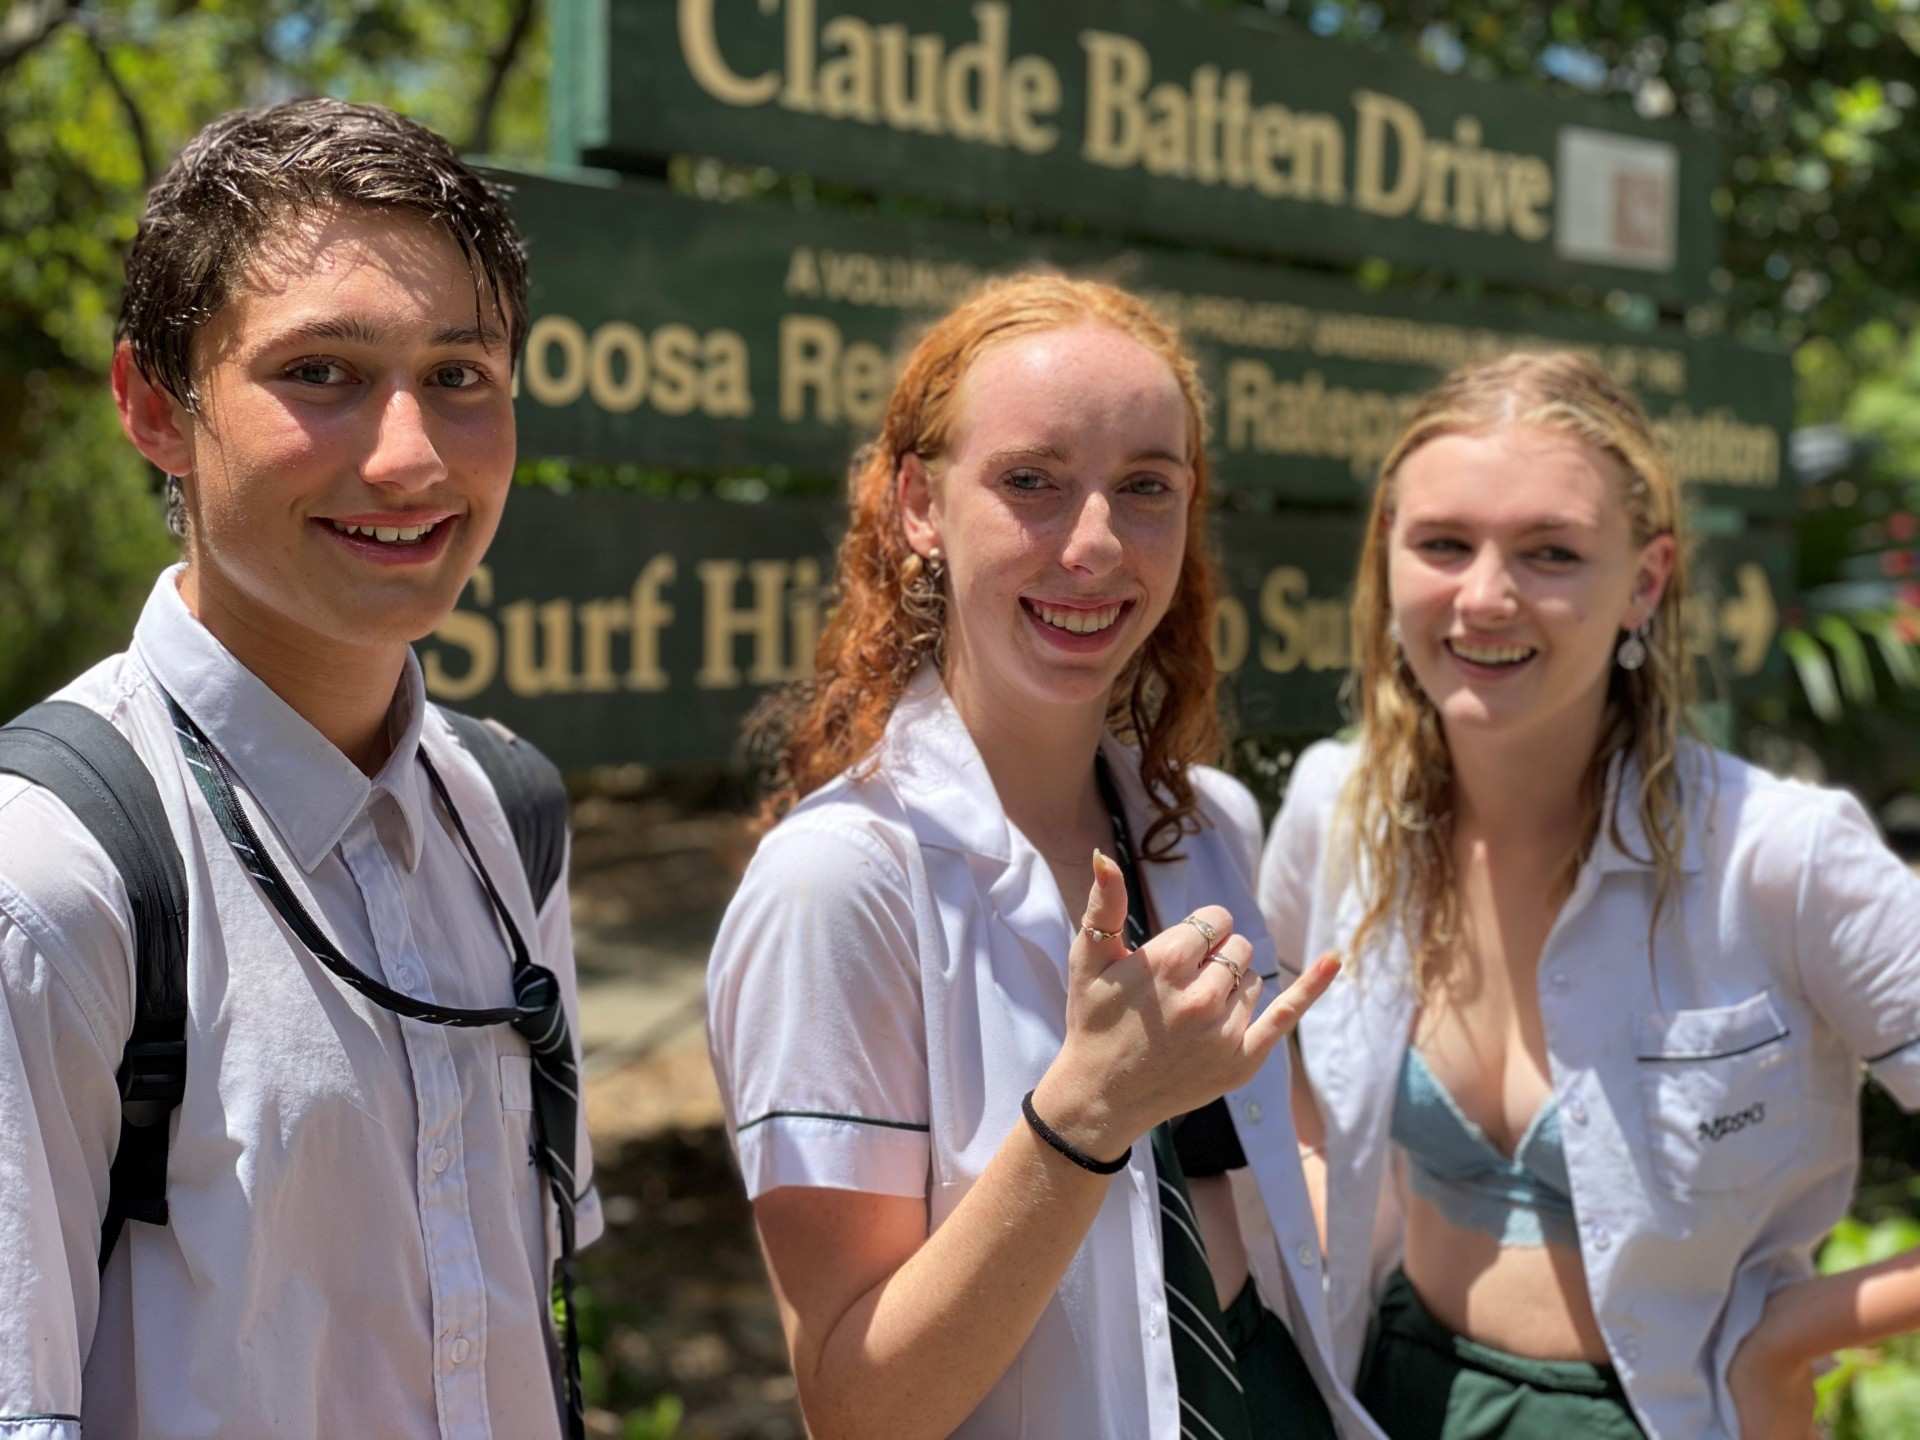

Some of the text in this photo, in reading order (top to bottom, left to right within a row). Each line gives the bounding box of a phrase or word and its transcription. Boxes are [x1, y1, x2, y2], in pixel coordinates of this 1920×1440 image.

[676, 0, 1553, 241] Claude Batten Drive
[512, 315, 753, 417] oosa
[422, 552, 678, 700] Surf
